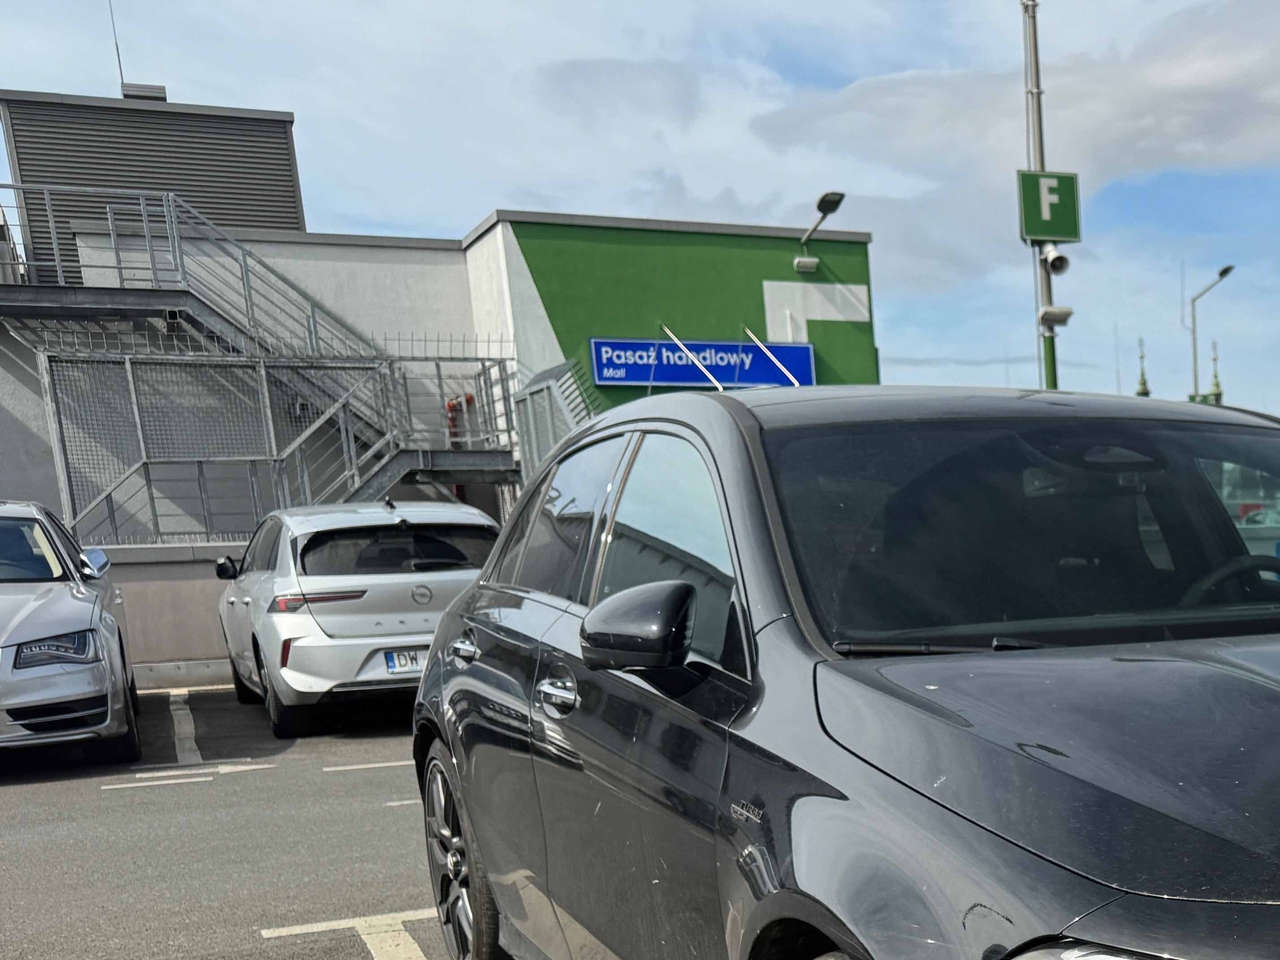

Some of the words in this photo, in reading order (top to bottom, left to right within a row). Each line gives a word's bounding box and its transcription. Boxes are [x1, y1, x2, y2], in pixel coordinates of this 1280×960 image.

[1039, 177, 1059, 221] F
[601, 346, 658, 365] Pasaż
[603, 367, 626, 379] Mall
[397, 651, 418, 668] DW
